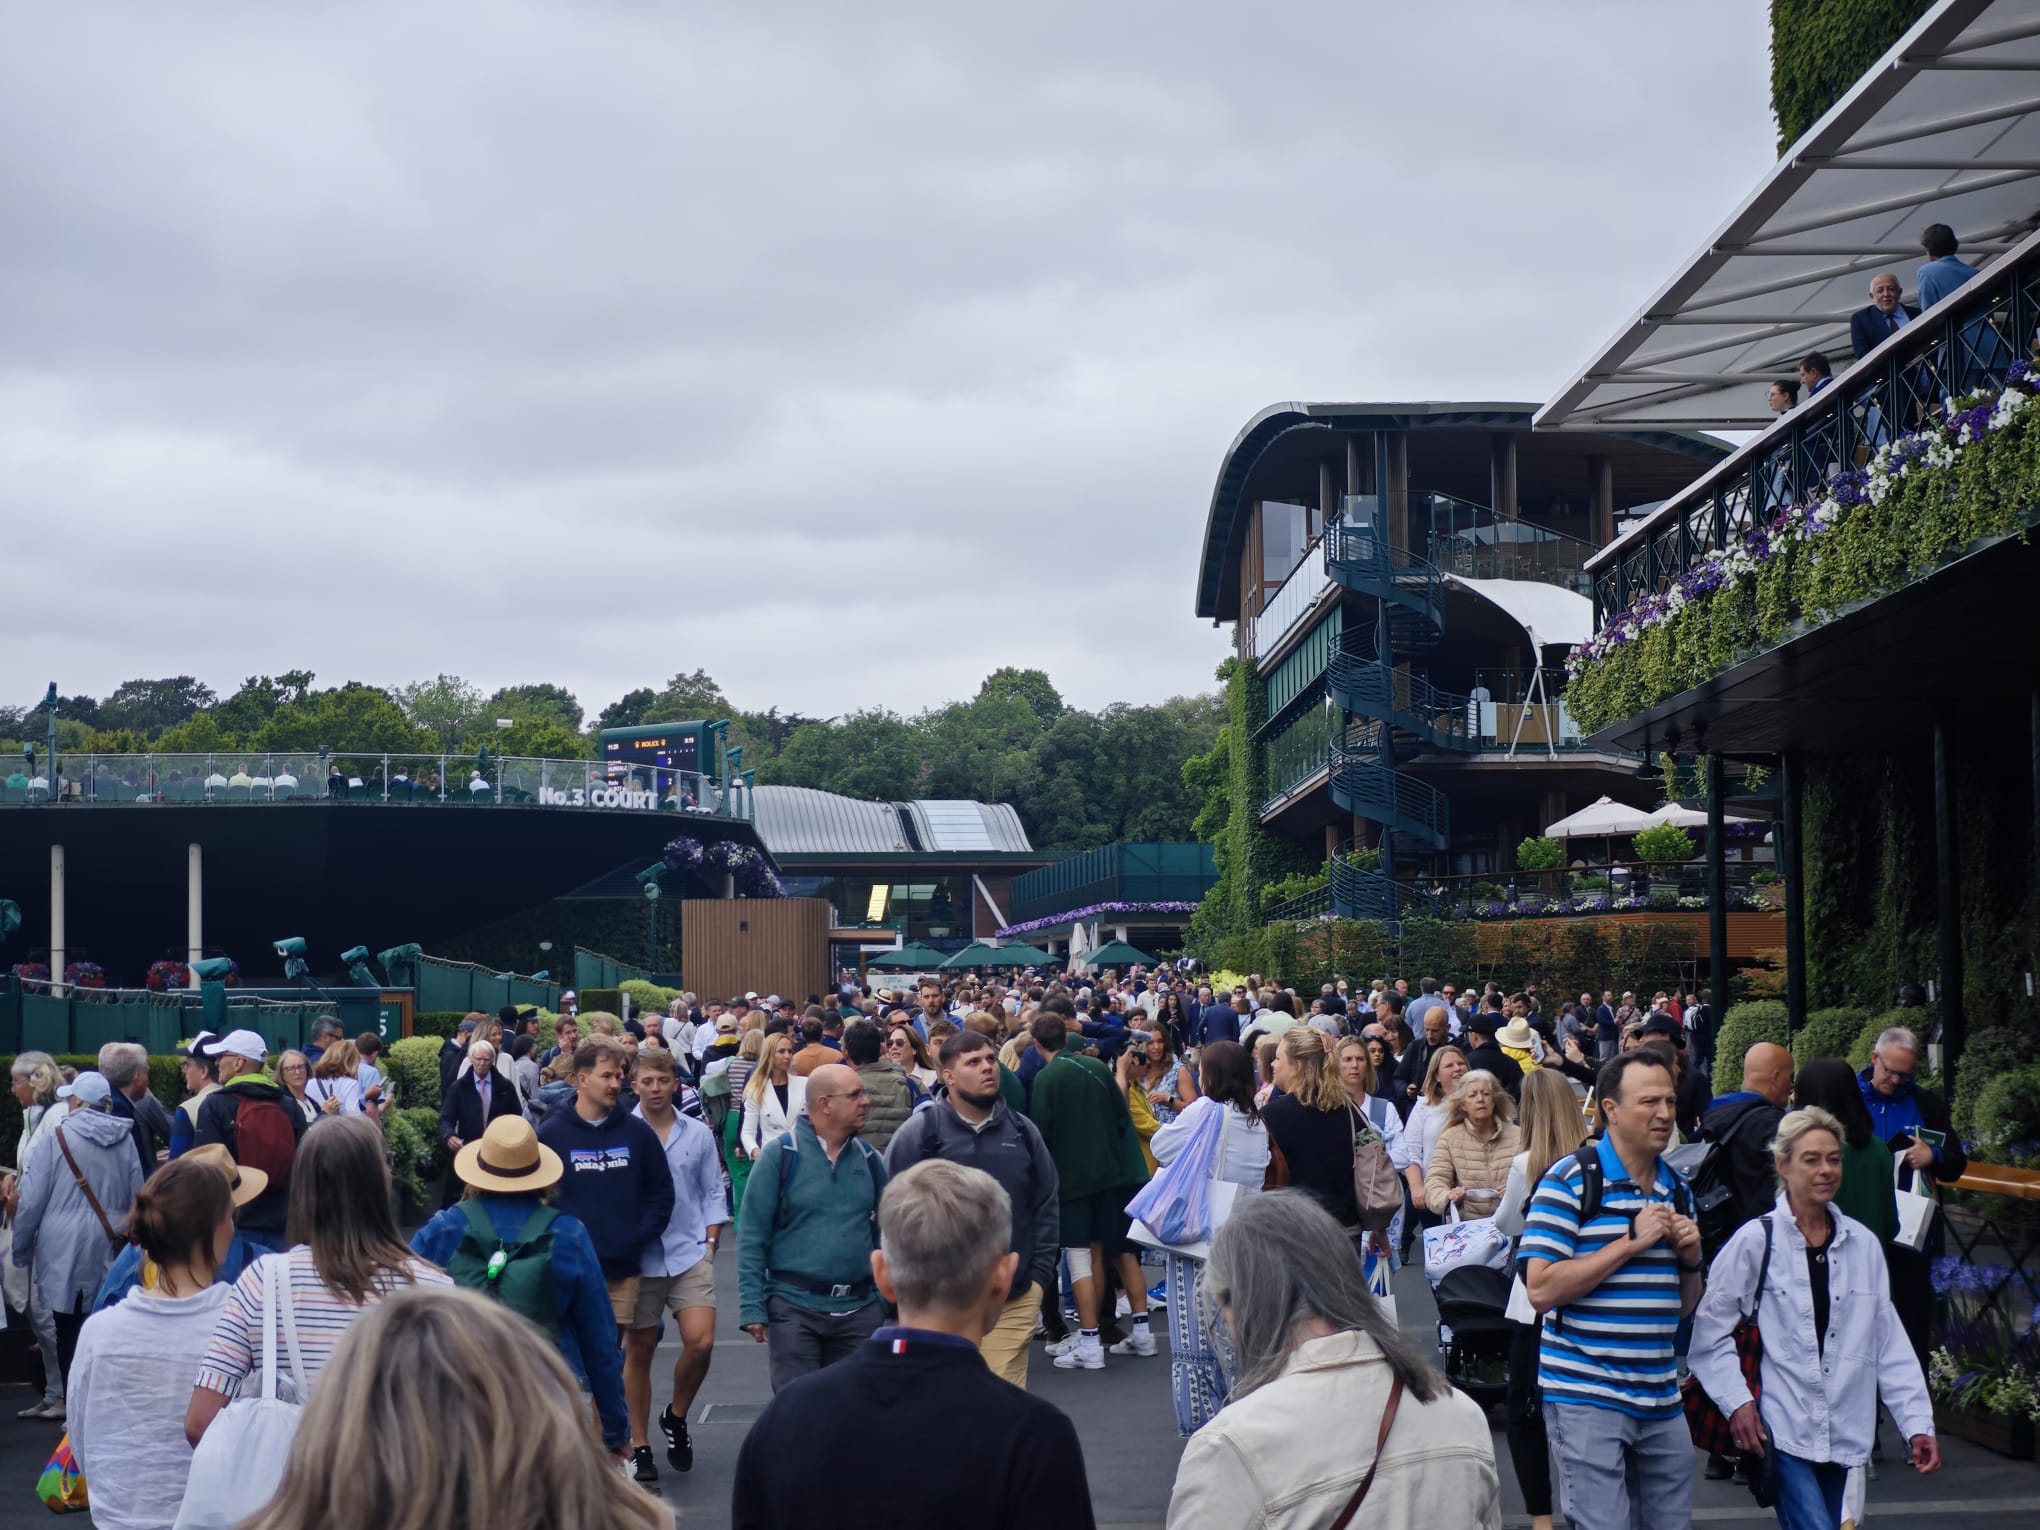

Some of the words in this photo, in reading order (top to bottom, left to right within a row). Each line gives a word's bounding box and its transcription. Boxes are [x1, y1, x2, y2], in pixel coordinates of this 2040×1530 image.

[641, 740, 660, 748] ROLEX
[539, 786, 585, 806] No.3
[591, 789, 659, 810] COURT
[574, 1157, 629, 1172] patagnia
